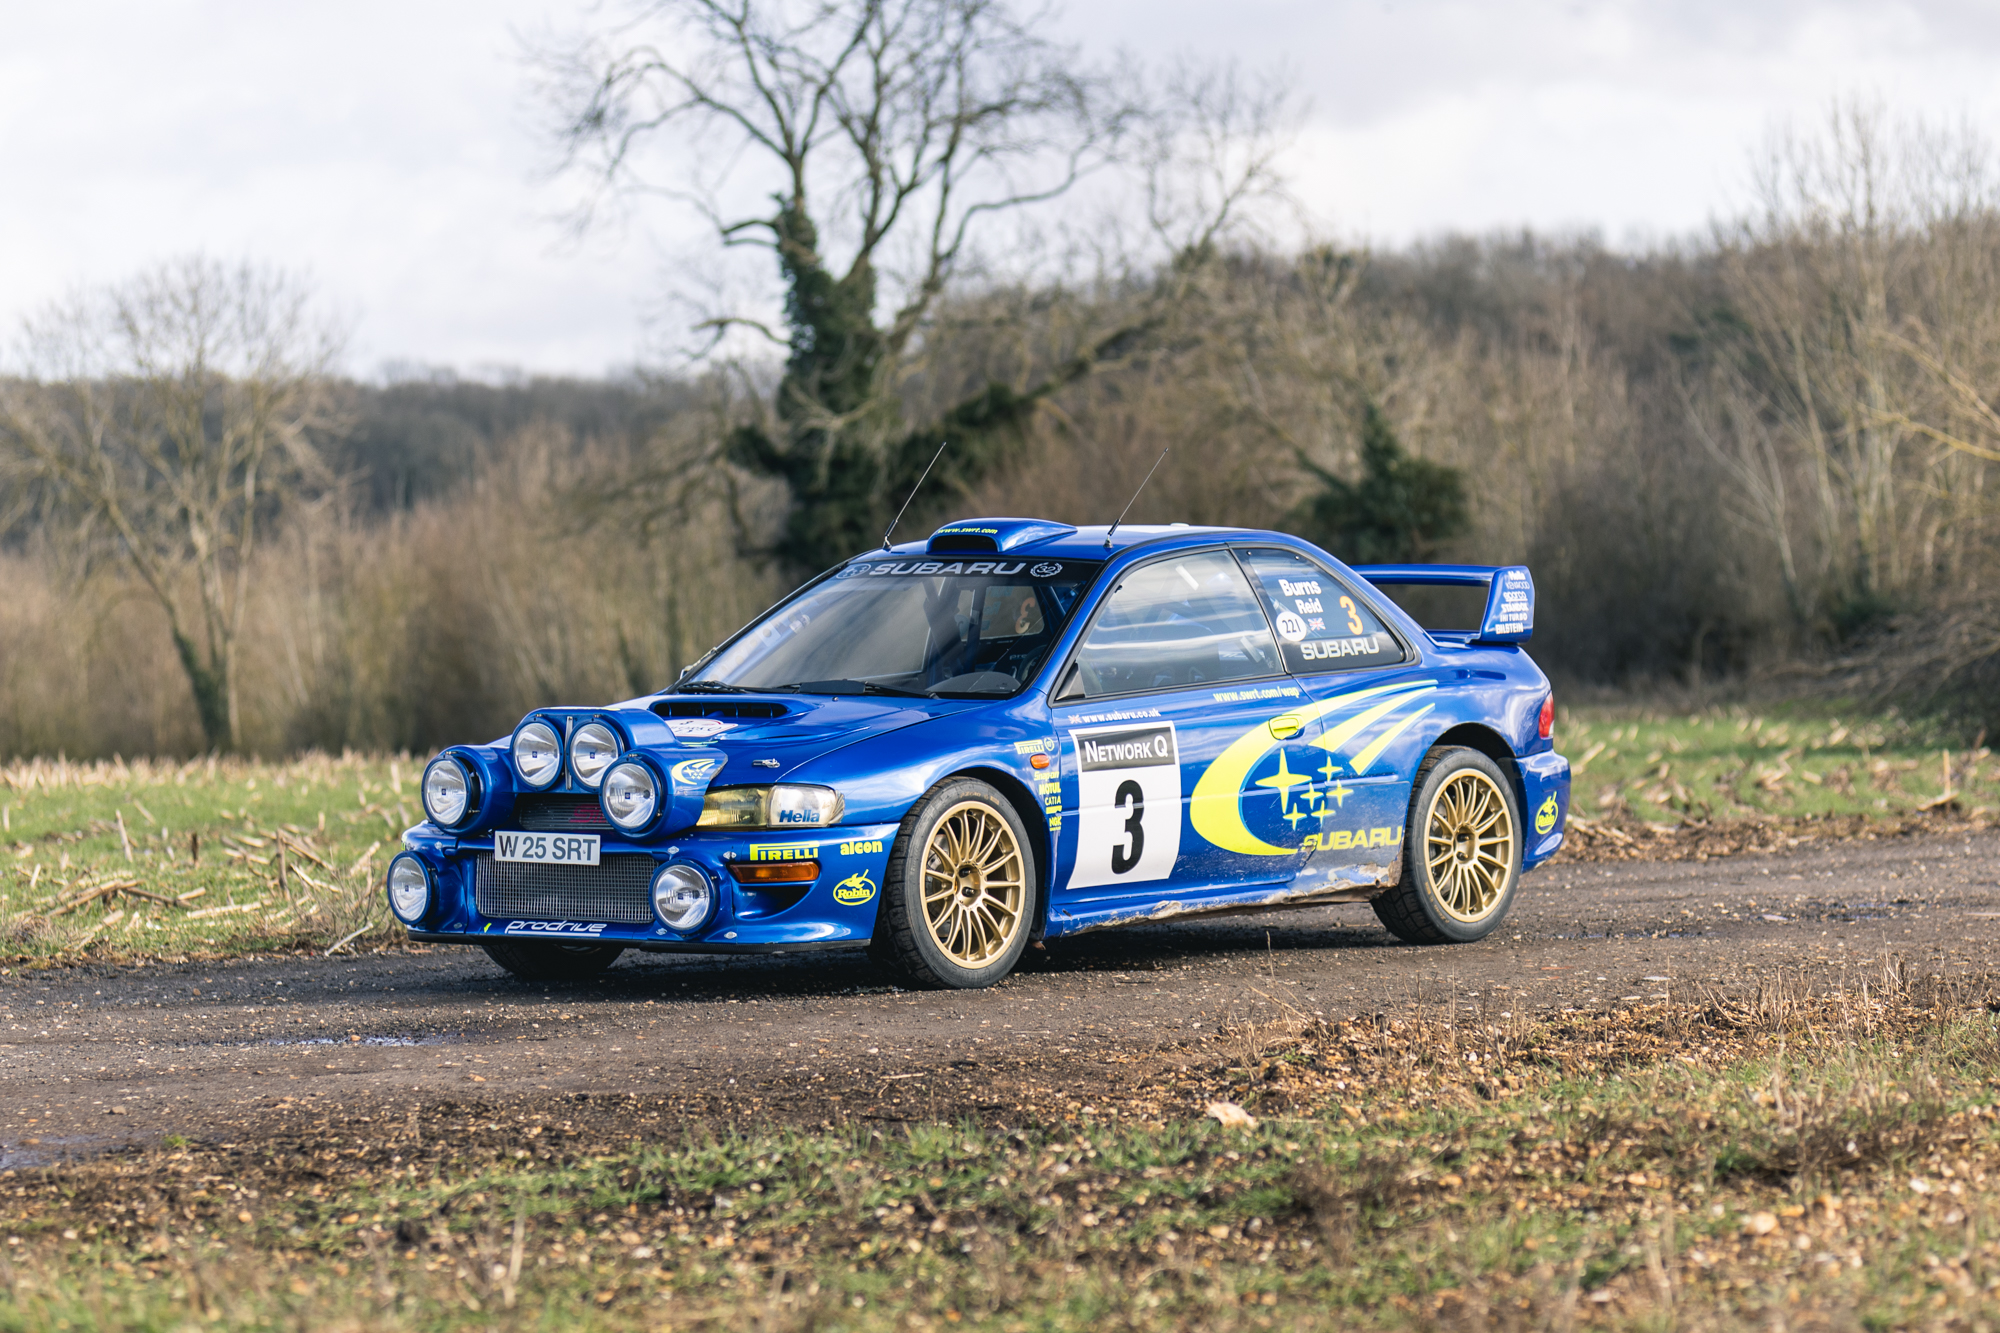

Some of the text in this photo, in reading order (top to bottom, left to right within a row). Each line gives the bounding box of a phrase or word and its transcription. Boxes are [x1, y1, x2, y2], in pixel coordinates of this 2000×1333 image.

[869, 562, 1026, 575] SUBARU
[1278, 579, 1322, 597] Burns
[1295, 598, 1324, 615] Reid
[1339, 595, 1364, 636] 3
[1495, 622, 1524, 635] BILSTEIN
[1300, 637, 1380, 660] SUBARU
[1212, 685, 1300, 703] www.swrt.com/wap
[1081, 708, 1162, 723] www.subaru.co.uk
[1013, 739, 1045, 755] PIRELLI
[1154, 735, 1168, 758] Q
[1038, 782, 1062, 796] MOTUL
[779, 809, 821, 823] Hella
[1111, 779, 1145, 875] 3
[1301, 826, 1402, 851] SUBARU
[551, 837, 597, 861] SRT
[750, 840, 820, 861] PIRELLI
[840, 840, 883, 856] alcon
[837, 886, 871, 900] Robin
[505, 920, 608, 935] prodrive
